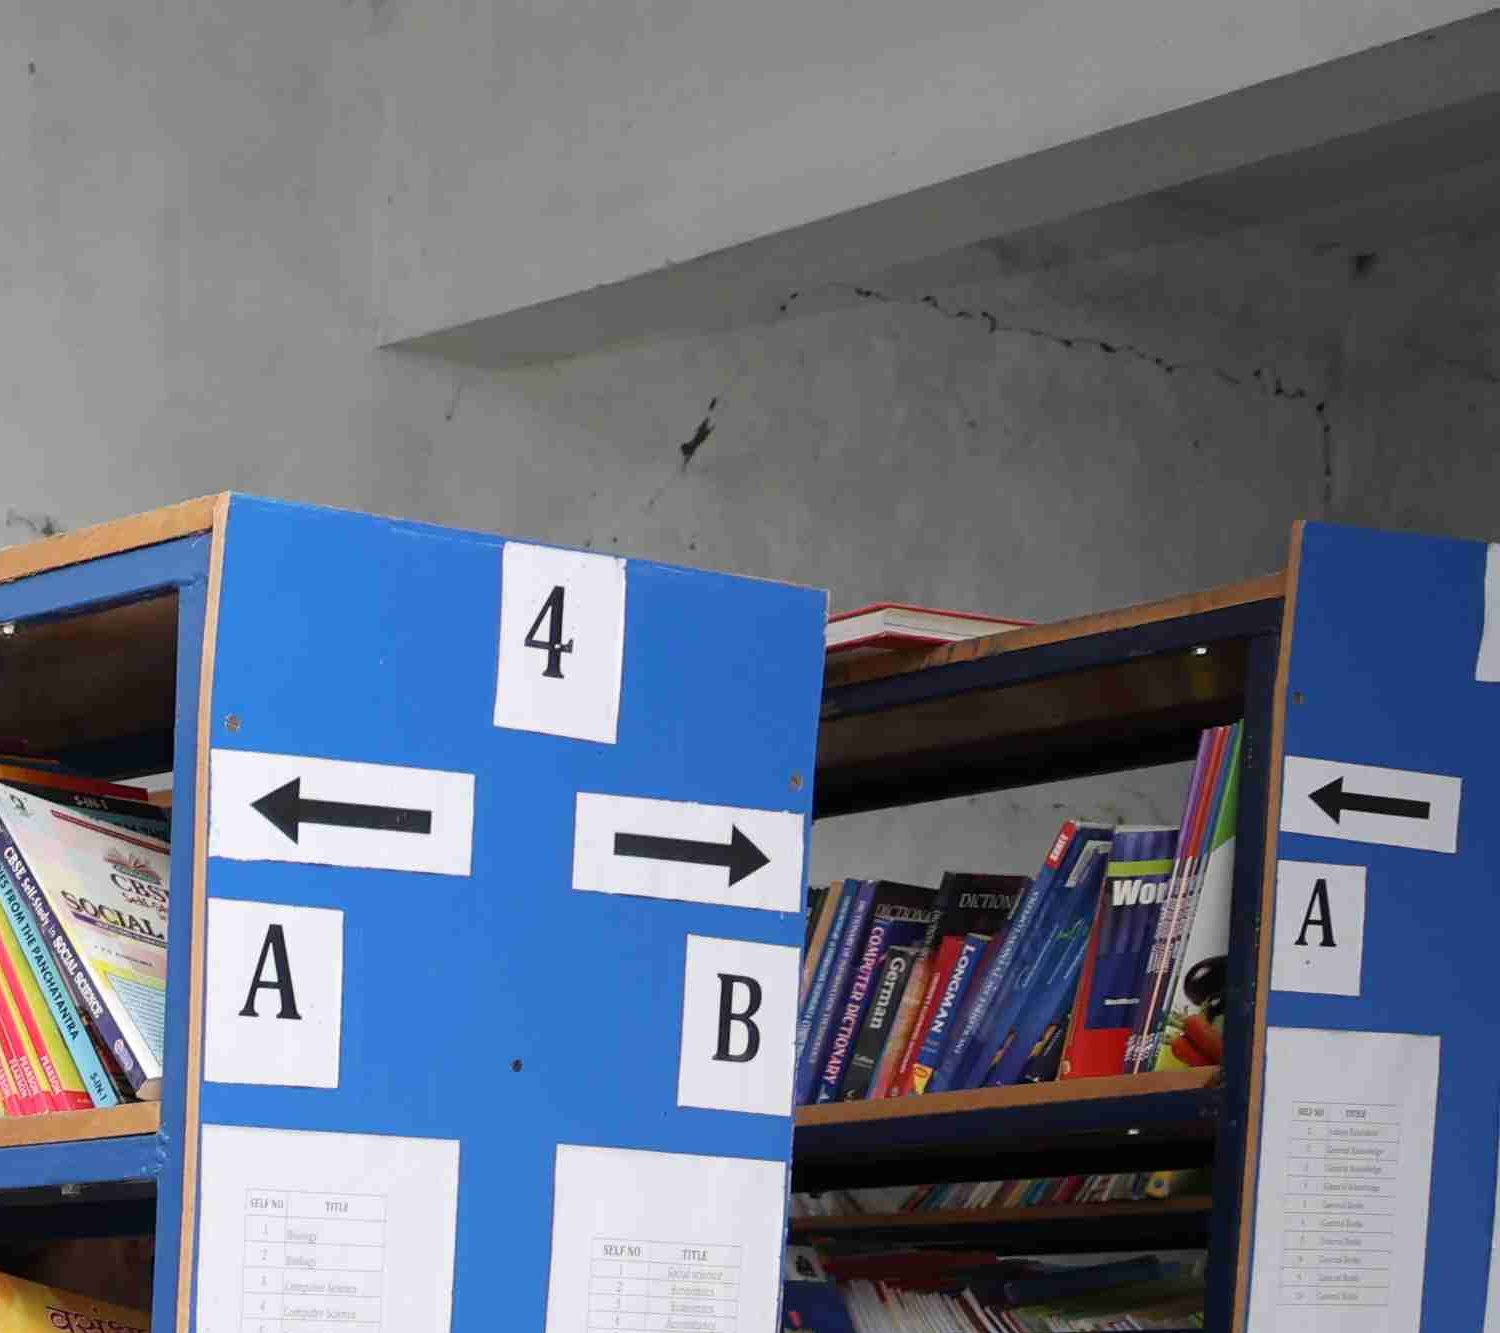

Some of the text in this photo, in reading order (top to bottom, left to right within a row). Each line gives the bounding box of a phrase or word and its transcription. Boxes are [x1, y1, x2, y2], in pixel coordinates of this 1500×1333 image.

[524, 585, 574, 679] 4
[3, 846, 25, 880] CBSE
[20, 879, 50, 928] Self-Study
[52, 935, 80, 977] SOCIAL
[74, 973, 104, 1019] SCIENCE
[60, 889, 164, 941] SOCIAL
[959, 892, 1015, 909] DICTION
[1293, 878, 1337, 948] A
[4, 885, 25, 923] FROM
[20, 920, 37, 947] THE
[32, 943, 79, 1042] PANCHATANTRA
[238, 924, 303, 1020] A
[823, 926, 884, 1085] COMPUTER DICTIONARY
[870, 957, 906, 1029] German
[931, 943, 976, 1034] LONGMAN
[712, 973, 762, 1063] B
